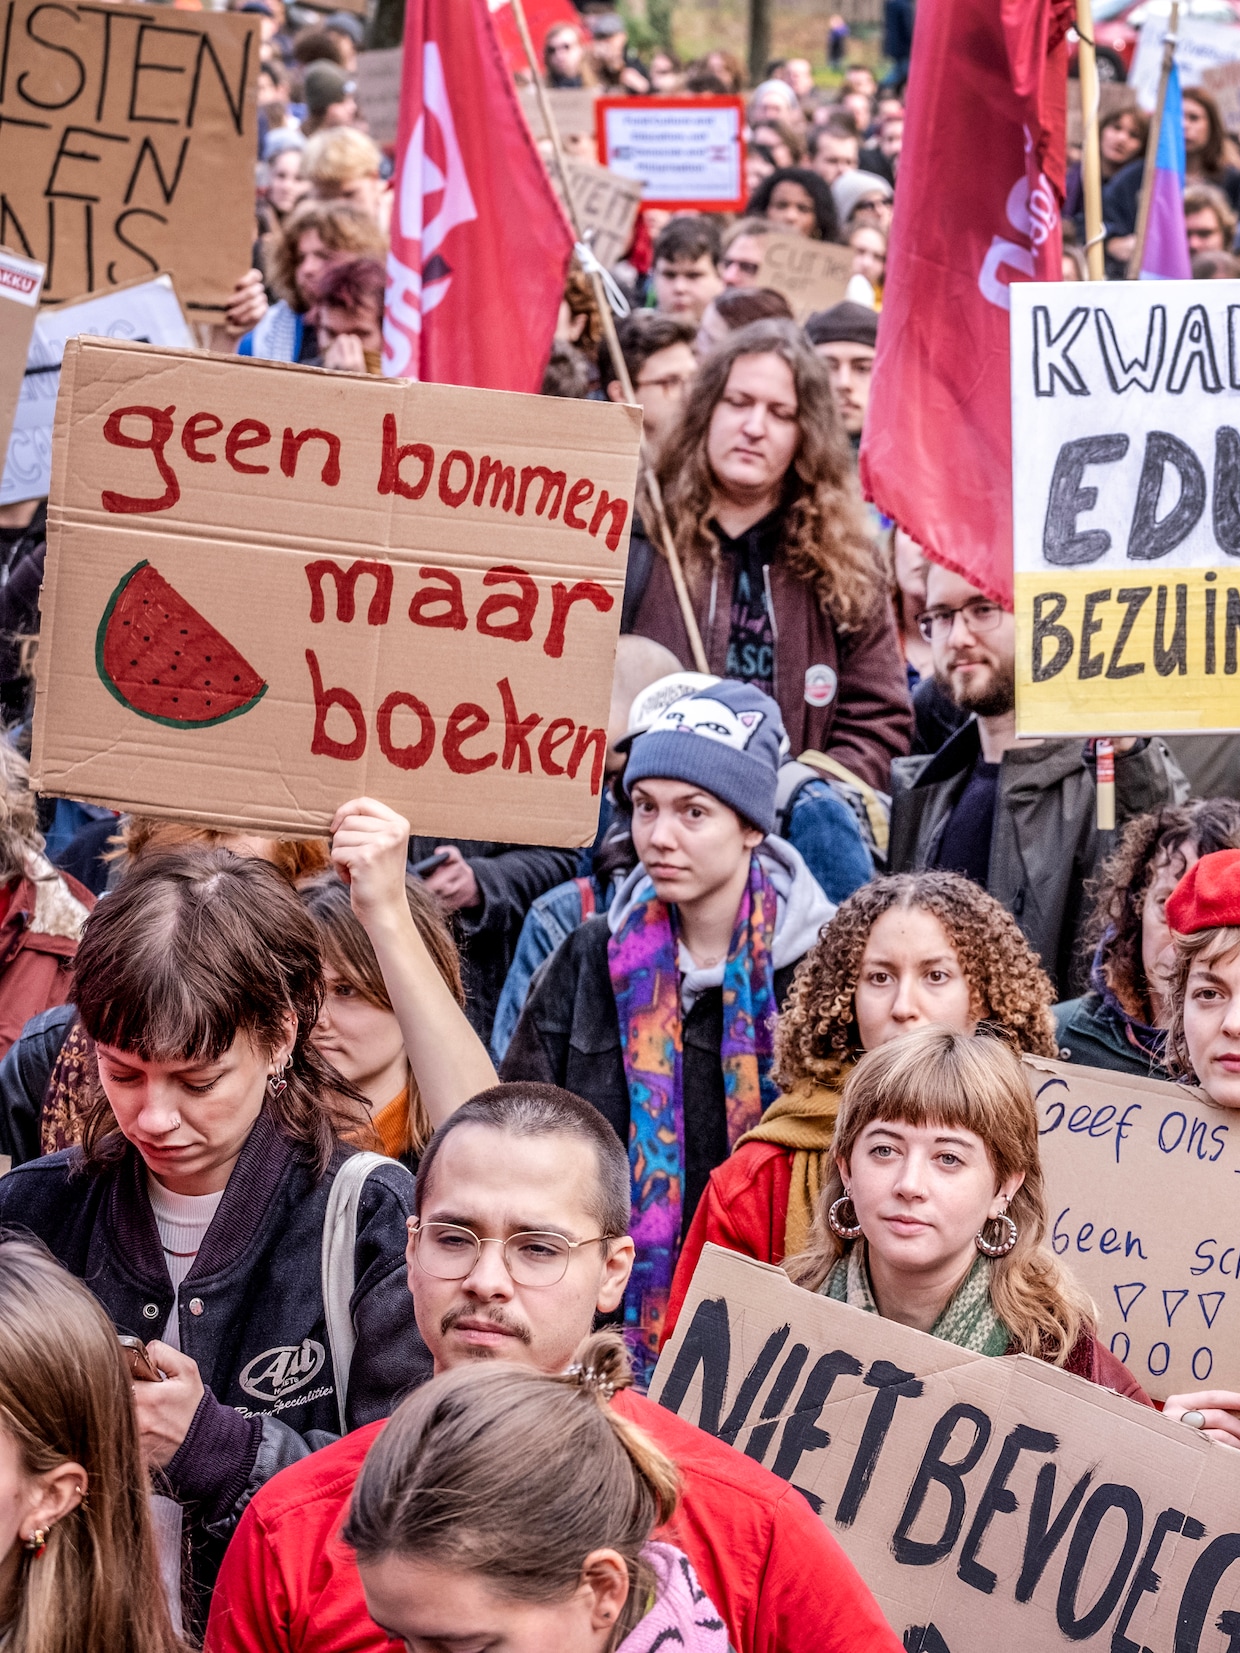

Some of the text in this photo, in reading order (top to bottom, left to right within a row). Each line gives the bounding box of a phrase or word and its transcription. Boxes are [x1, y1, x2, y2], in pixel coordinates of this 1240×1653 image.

[101, 404, 341, 514] geen
[376, 412, 629, 552] bommen
[304, 557, 615, 659] maar
[304, 647, 607, 797] boeken
[1034, 1078, 1142, 1163] Geef
[1157, 1110, 1229, 1162] Ons
[273, 1385, 335, 1415] Specialities
[658, 1297, 926, 1532] NIET
